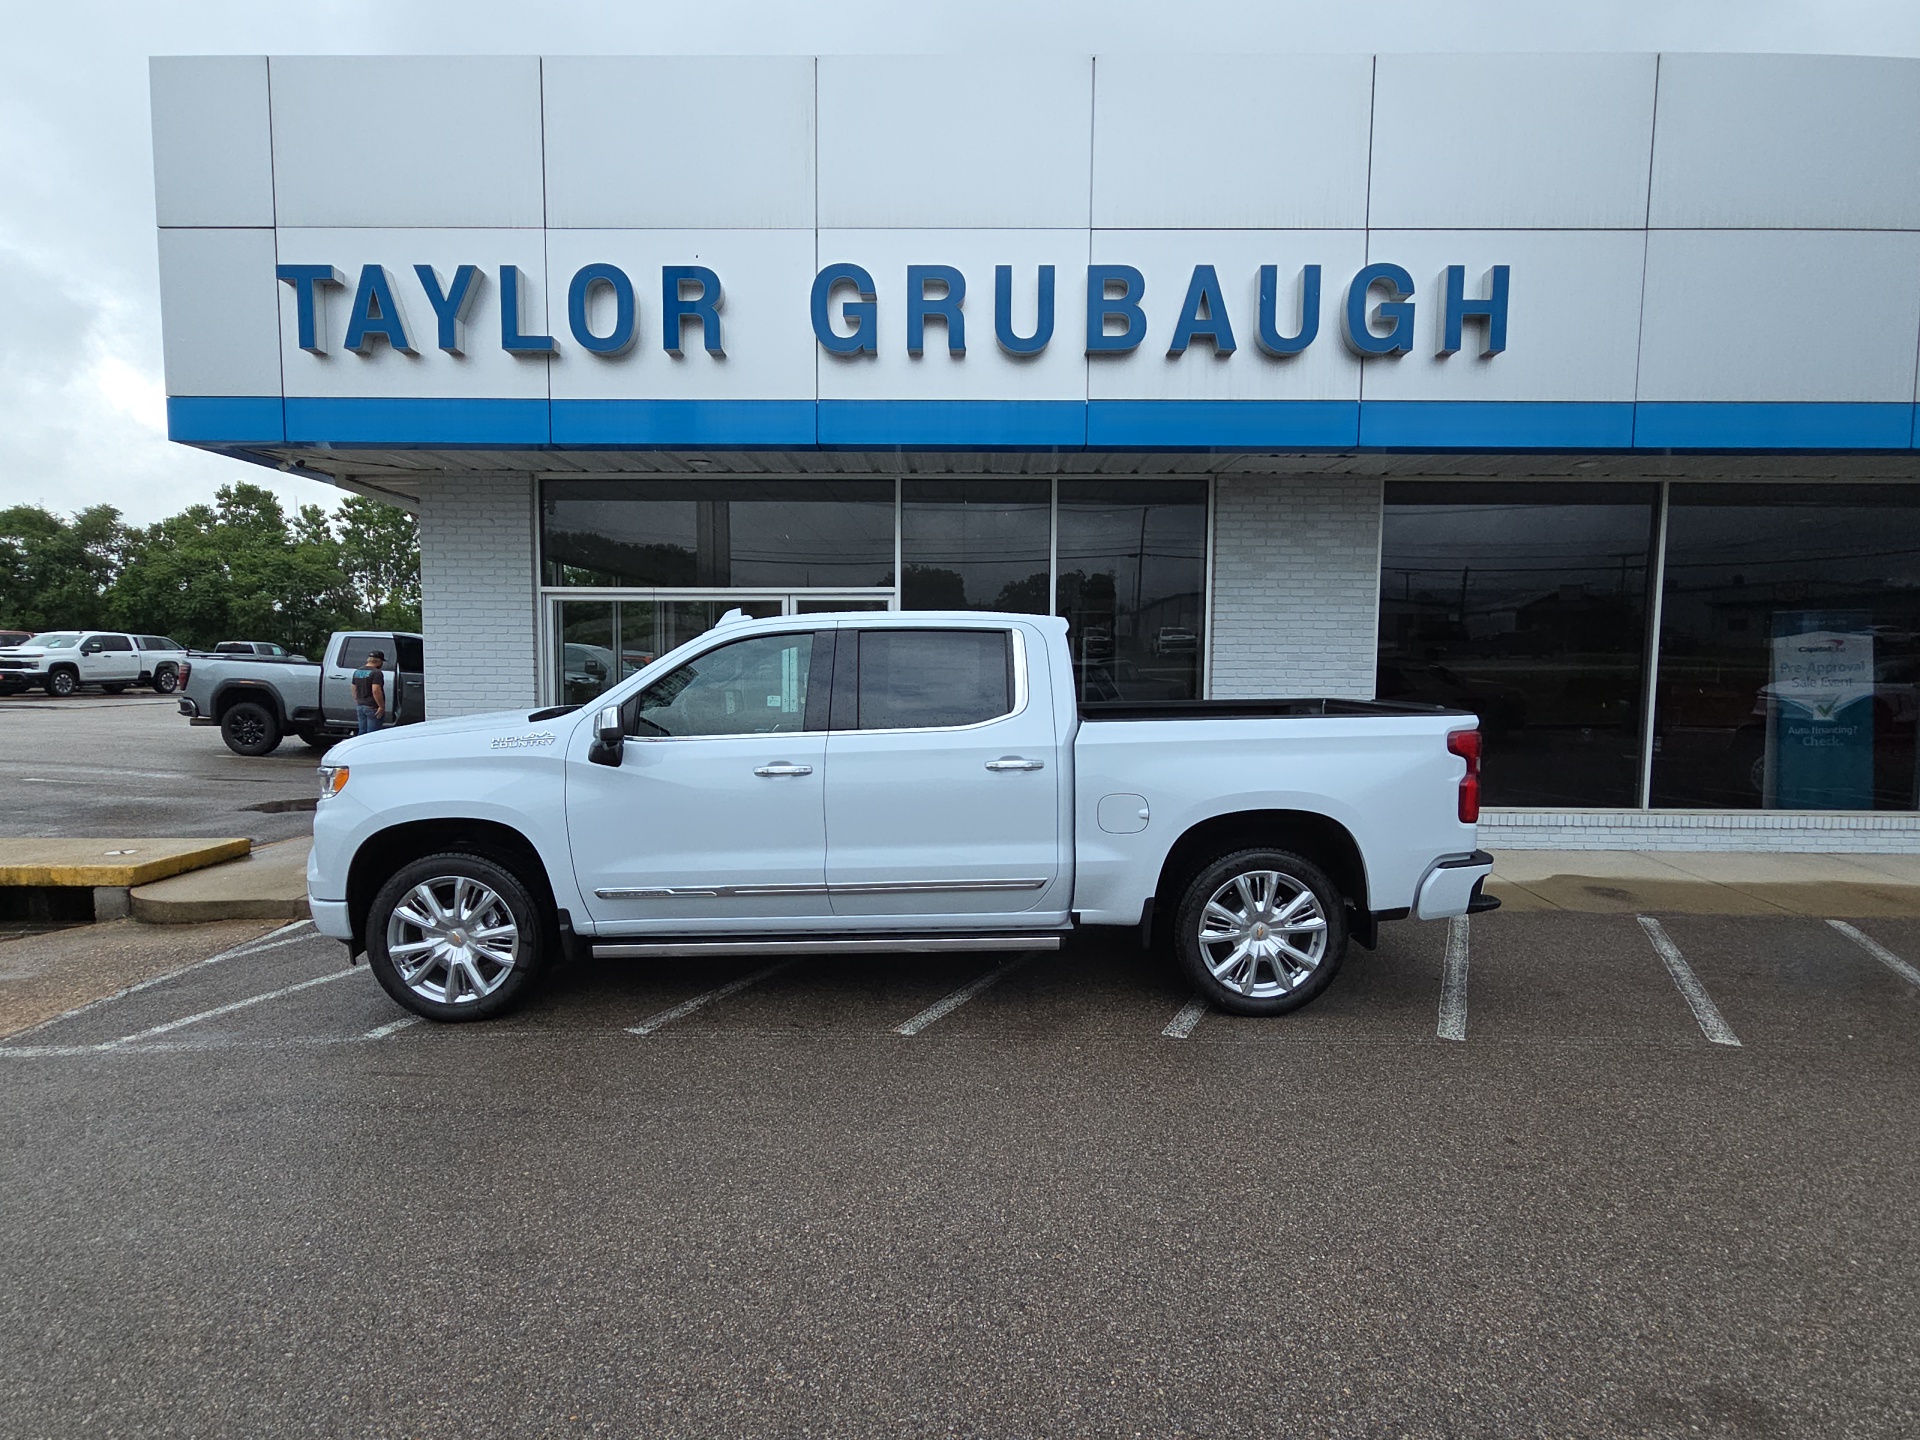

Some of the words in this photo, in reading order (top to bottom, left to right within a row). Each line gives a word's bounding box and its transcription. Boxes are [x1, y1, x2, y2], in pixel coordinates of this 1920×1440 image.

[276, 263, 727, 359] TAYLOR
[810, 262, 1511, 360] GRUBAUGH
[1780, 660, 1866, 675] Pre-Approval
[1791, 676, 1817, 688] Sale
[1821, 676, 1853, 688] Event
[1788, 726, 1809, 735] Auto
[490, 739, 557, 750] COUNTRY
